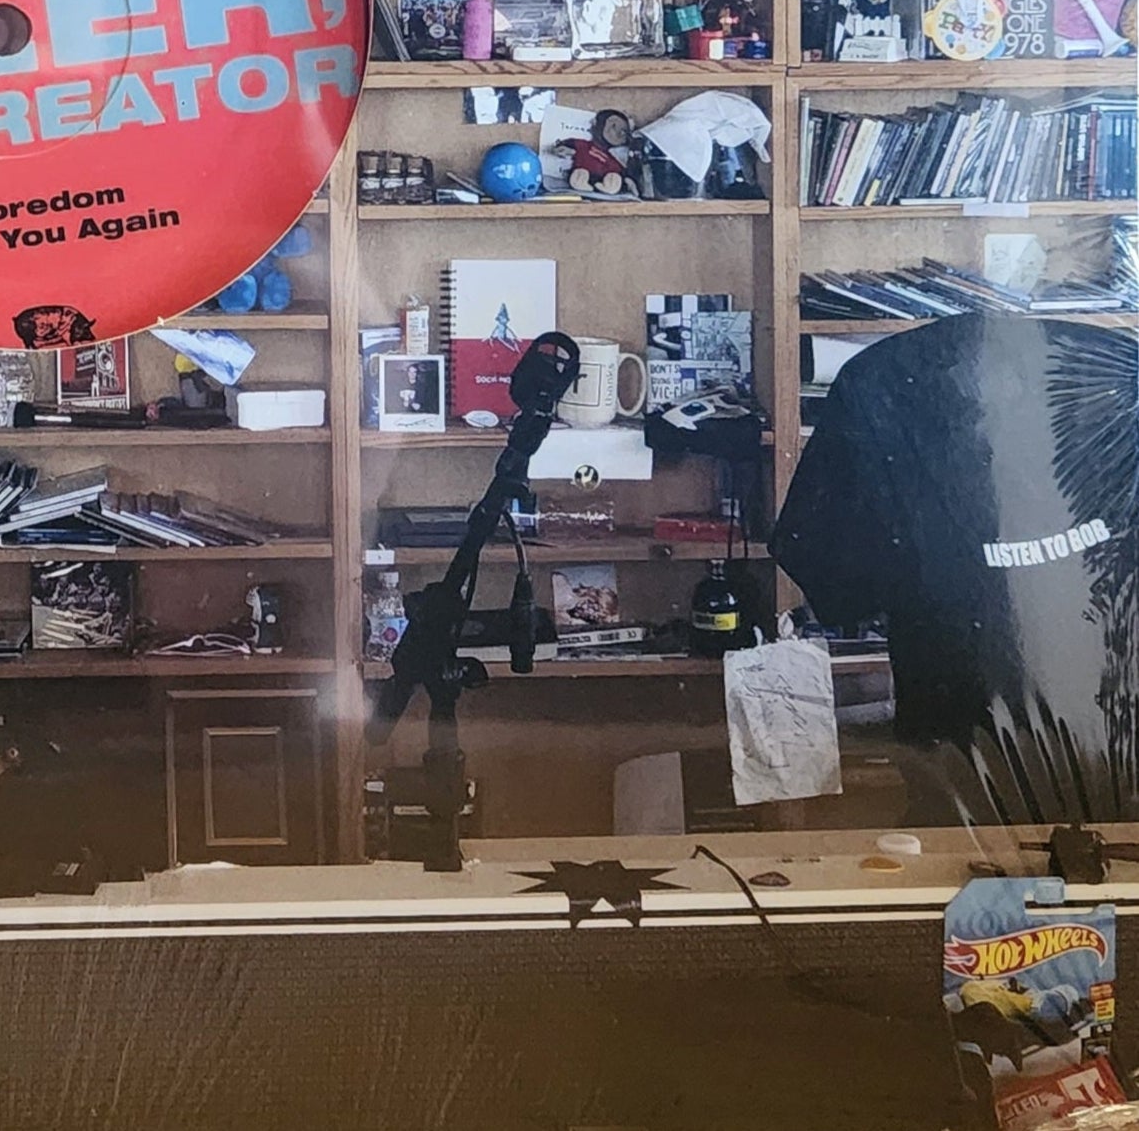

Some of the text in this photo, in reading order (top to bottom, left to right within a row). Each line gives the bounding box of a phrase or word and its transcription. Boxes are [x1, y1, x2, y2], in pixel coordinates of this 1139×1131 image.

[1003, 33, 1045, 56] 978
[6, 223, 66, 251] You
[77, 206, 181, 245] Again
[982, 518, 1111, 567] LISTEN TO BOB
[971, 935, 1025, 976] HOT
